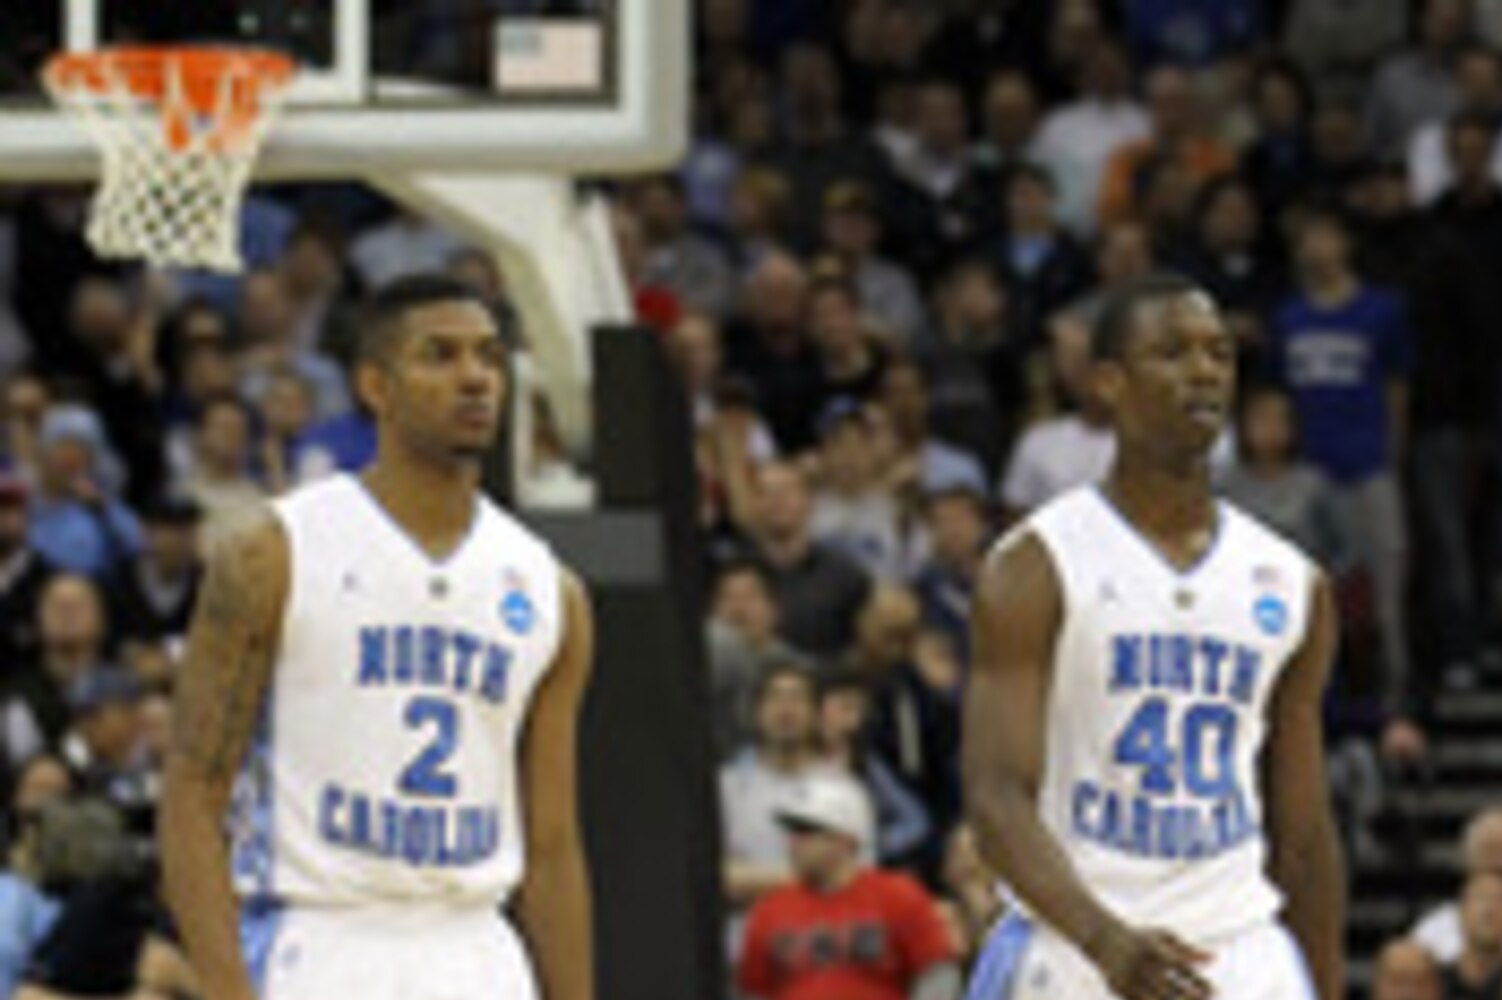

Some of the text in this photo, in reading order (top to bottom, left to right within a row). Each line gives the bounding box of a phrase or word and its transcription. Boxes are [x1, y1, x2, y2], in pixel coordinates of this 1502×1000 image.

[357, 624, 513, 704] NORTH
[1107, 632, 1261, 706] NORTH
[396, 695, 460, 798] 2
[1113, 695, 1240, 799] 40
